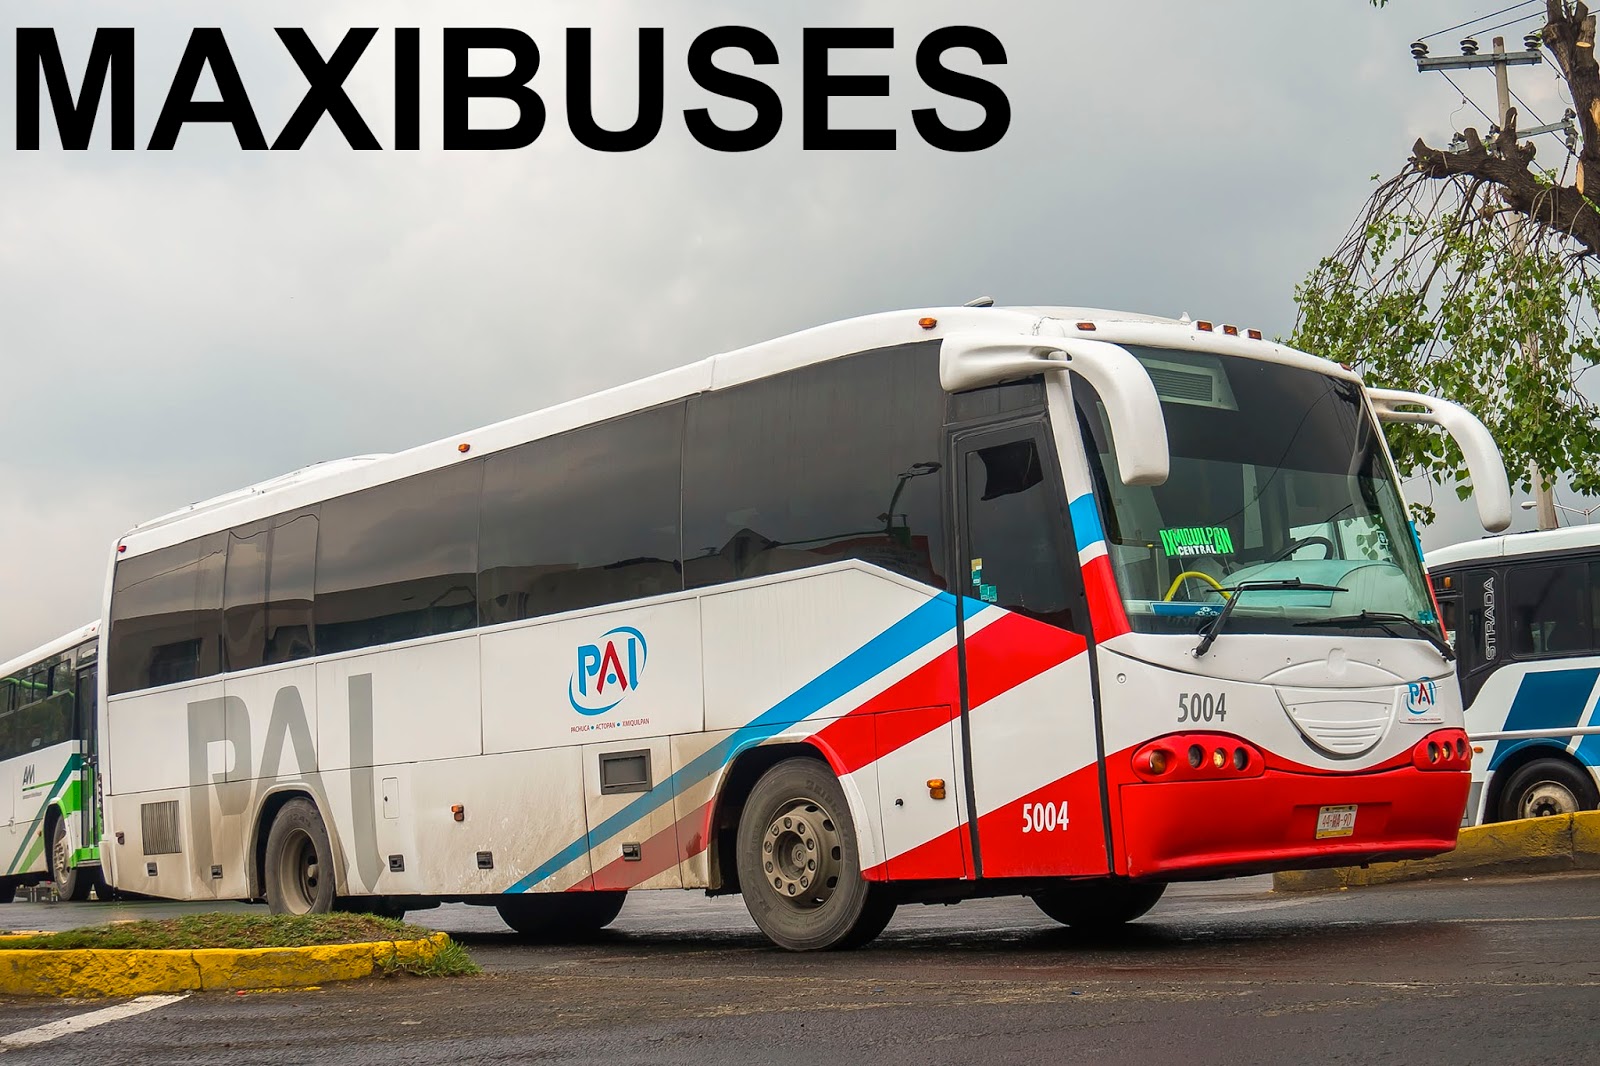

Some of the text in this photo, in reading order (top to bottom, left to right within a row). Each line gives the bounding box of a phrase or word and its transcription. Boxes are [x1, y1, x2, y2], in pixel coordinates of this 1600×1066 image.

[1177, 544, 1217, 556] CENTRAL
[1483, 576, 1497, 661] STRADA
[577, 637, 639, 697] PAI
[1177, 692, 1227, 723] 5004
[1408, 682, 1436, 706] PAI
[595, 722, 616, 731] ACTOPAN
[187, 673, 386, 899] PAI
[1021, 800, 1070, 833] 5004
